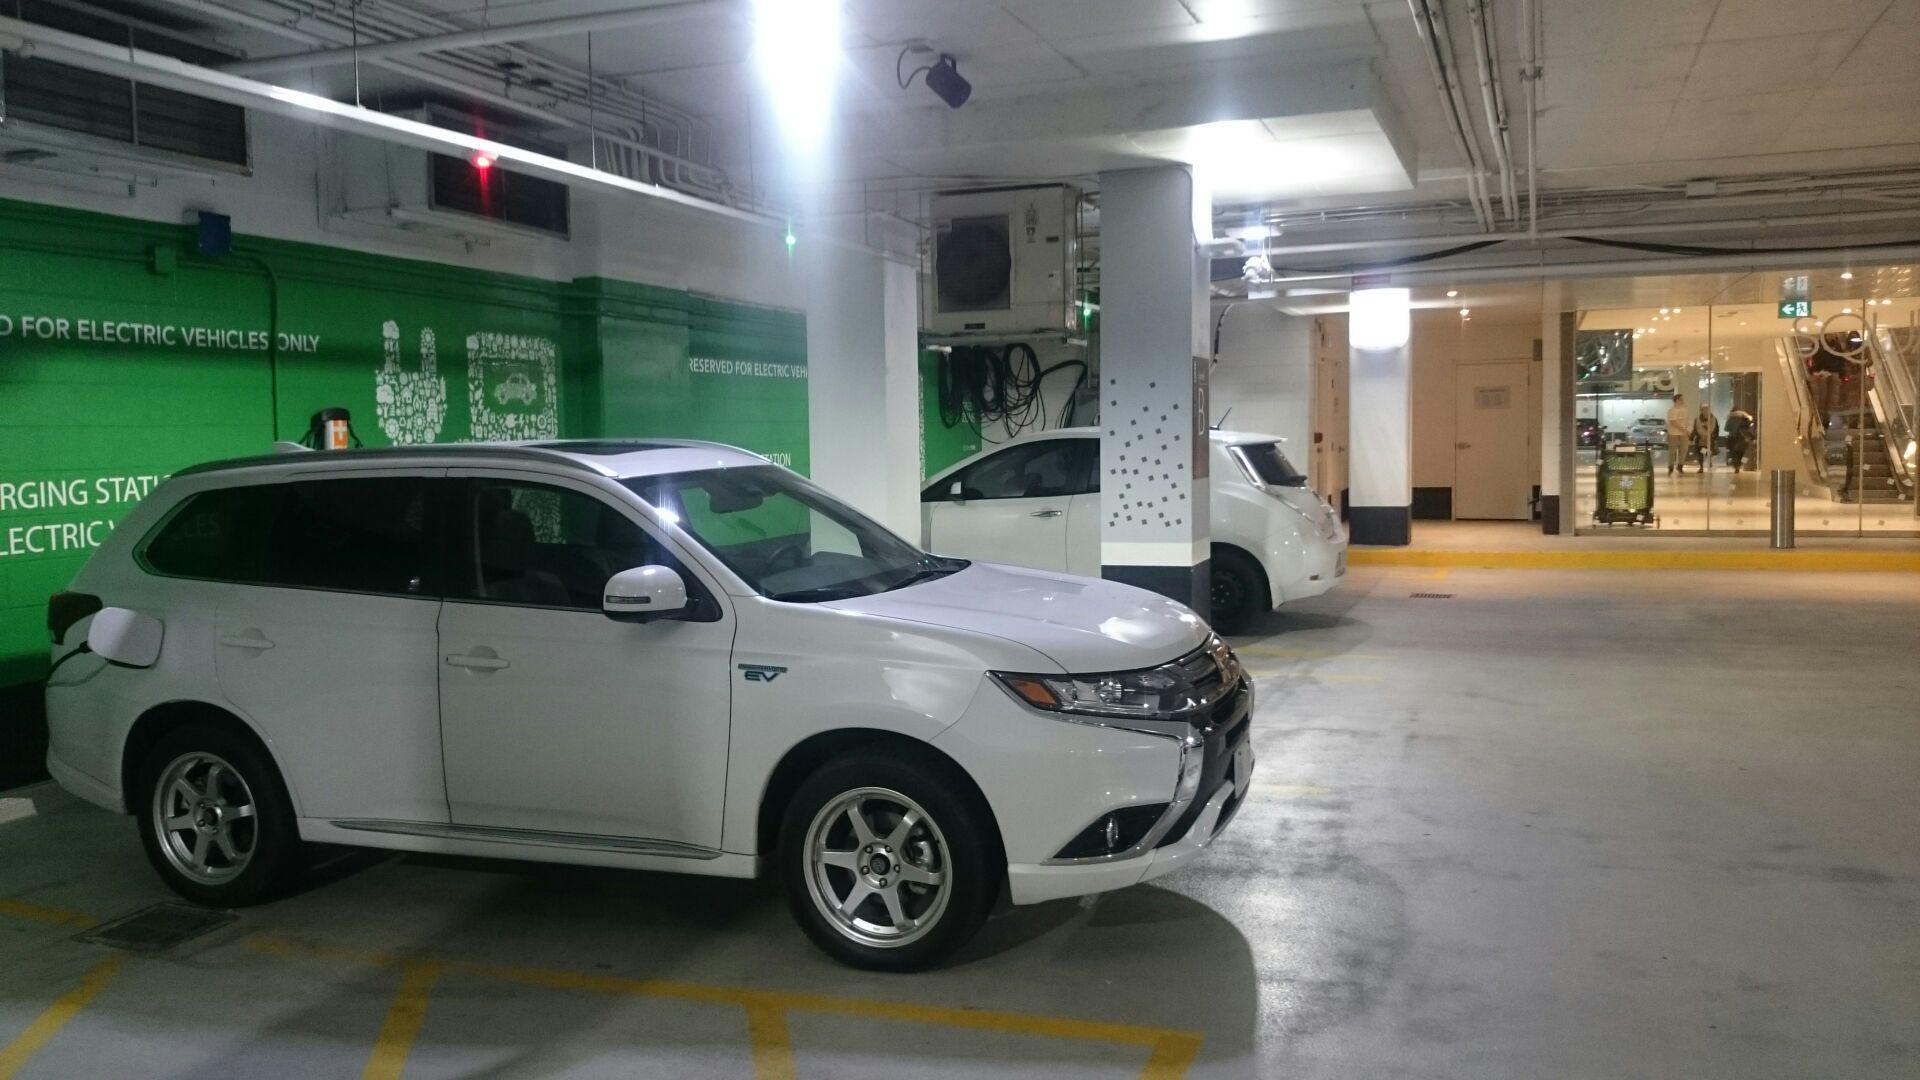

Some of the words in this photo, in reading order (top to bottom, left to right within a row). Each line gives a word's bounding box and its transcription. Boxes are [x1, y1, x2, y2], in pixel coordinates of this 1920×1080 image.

[22, 316, 70, 339] FOR
[77, 319, 176, 345] ELECTRIC
[181, 326, 269, 350] VEHICLES
[278, 332, 320, 352] ONLY
[689, 358, 733, 374] RESERVED
[735, 361, 752, 376] FOR
[754, 363, 790, 378] ELECTRIC
[0, 479, 88, 511] RGING
[95, 474, 172, 503] STAT
[744, 670, 779, 682] EV
